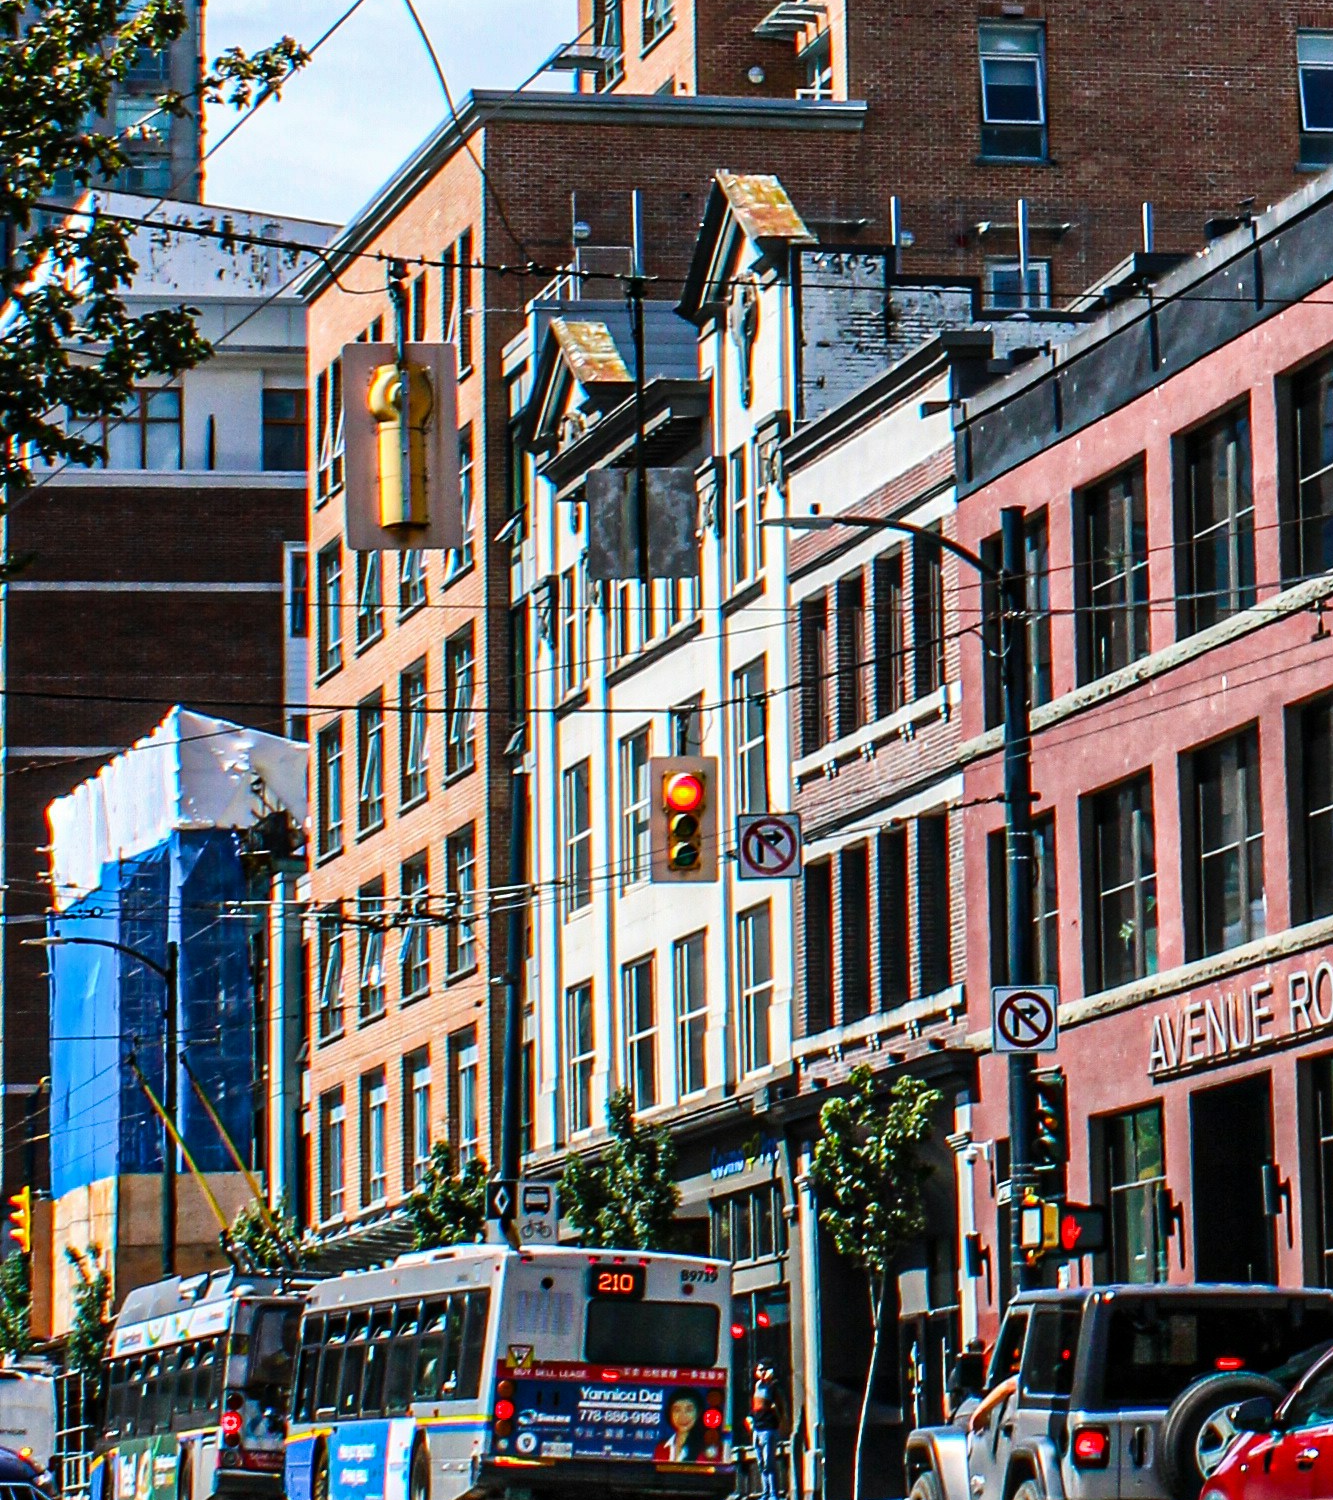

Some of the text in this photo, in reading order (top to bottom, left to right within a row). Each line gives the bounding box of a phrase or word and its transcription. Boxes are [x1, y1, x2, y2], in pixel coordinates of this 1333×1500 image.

[1147, 982, 1274, 1074] AVENUE
[598, 1273, 633, 1292] 210
[581, 1387, 664, 1403] Yannica Dai
